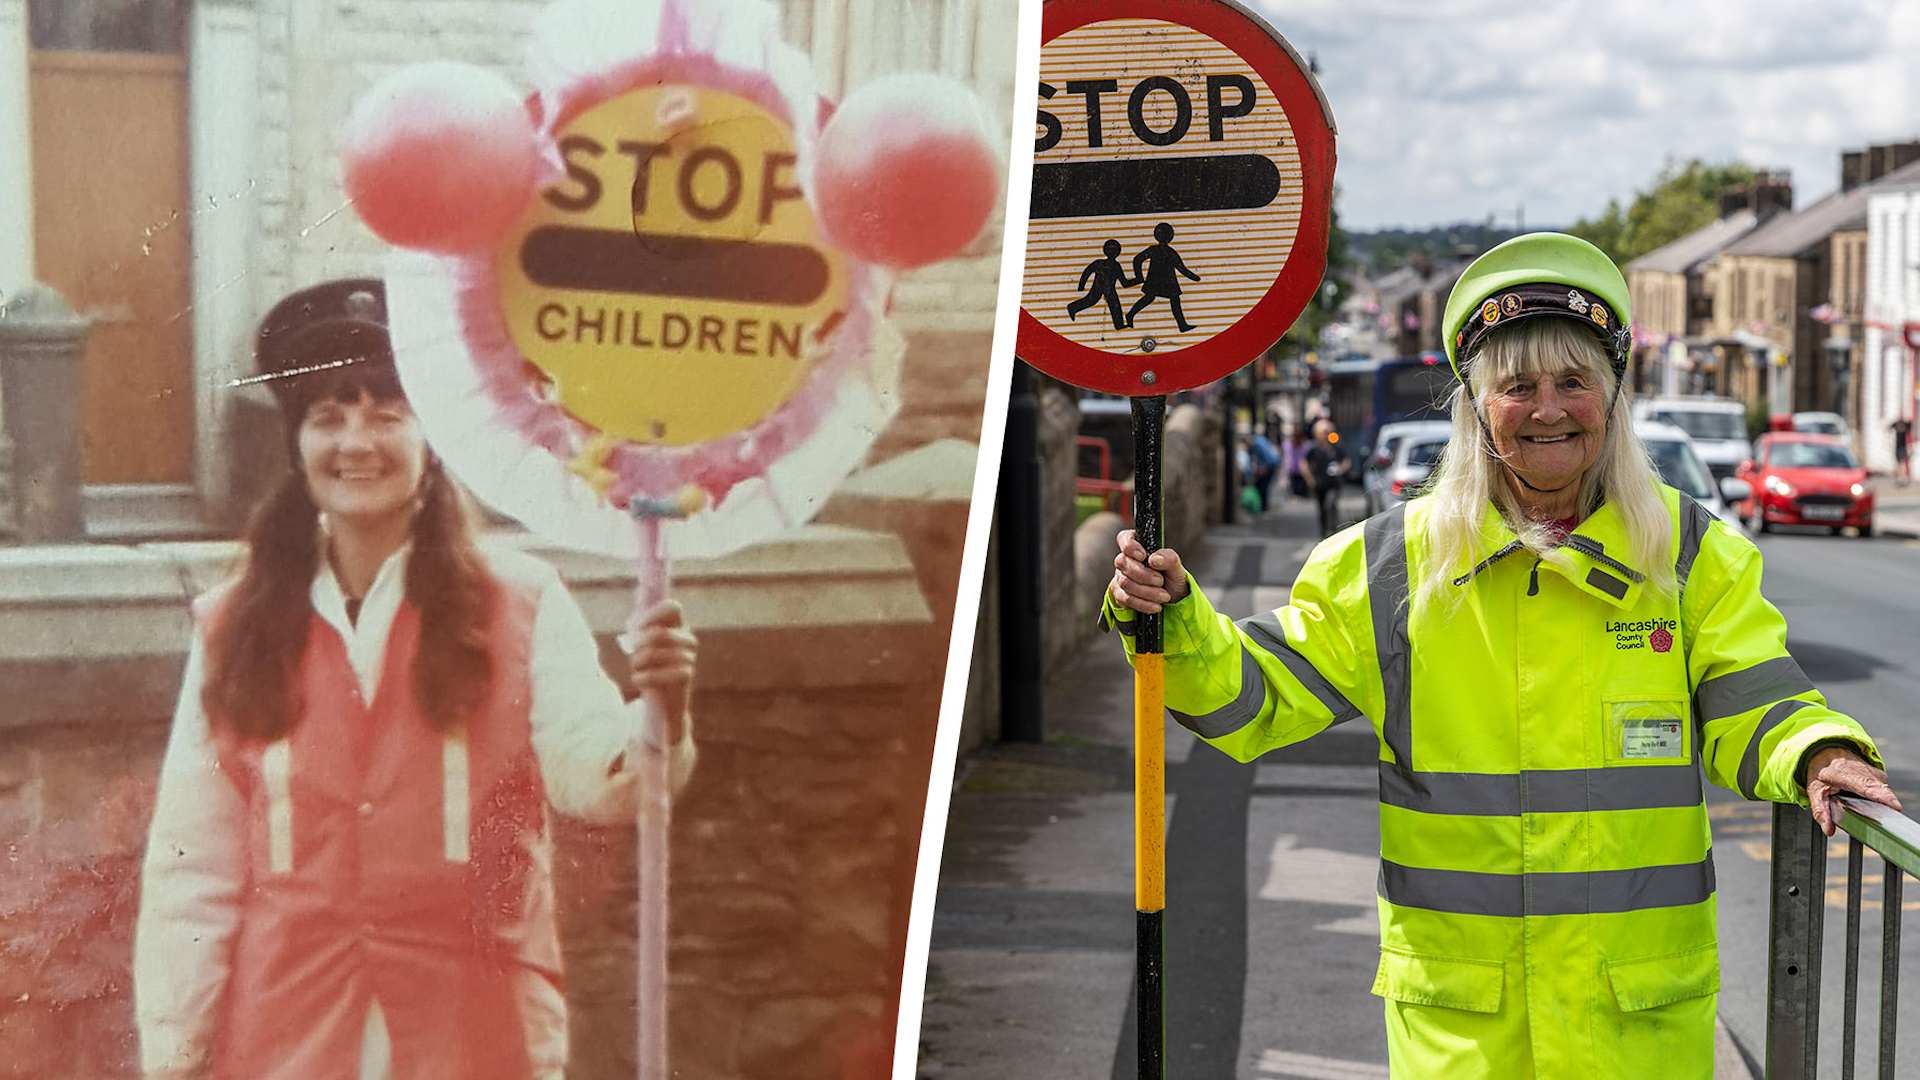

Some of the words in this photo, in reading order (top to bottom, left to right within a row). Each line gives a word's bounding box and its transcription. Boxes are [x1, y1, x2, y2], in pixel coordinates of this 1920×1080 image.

[535, 303, 805, 358] CHILDREN
[1606, 617, 1677, 633] Lancashire
[1616, 633, 1643, 642] County
[1616, 642, 1645, 650] Council
